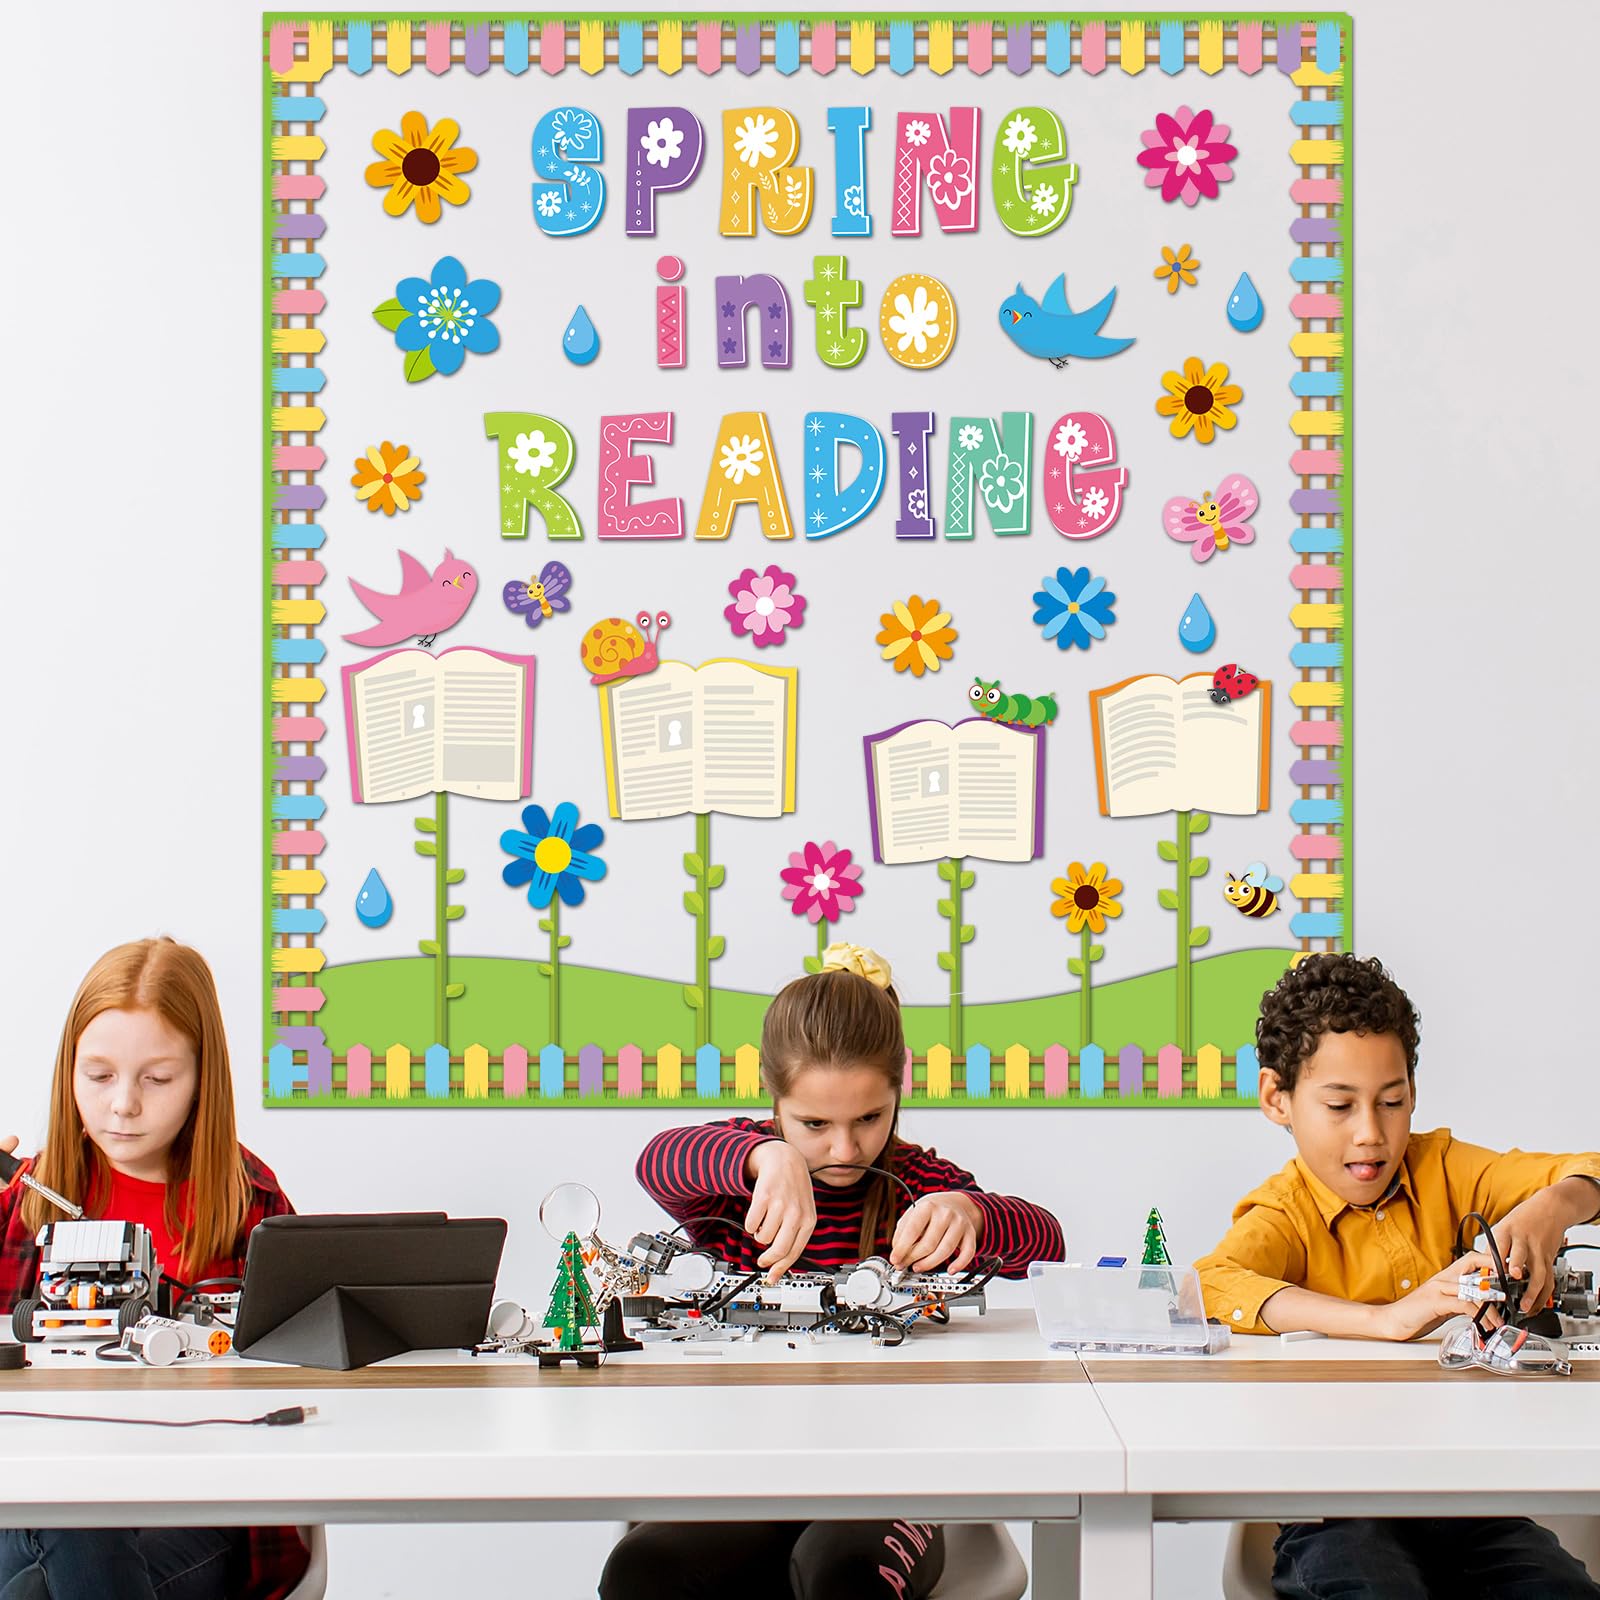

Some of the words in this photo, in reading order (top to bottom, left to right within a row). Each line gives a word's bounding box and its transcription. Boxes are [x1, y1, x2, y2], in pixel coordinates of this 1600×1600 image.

[532, 106, 1079, 237] SPRING
[656, 255, 958, 369] into
[484, 411, 1128, 540] READING
[879, 1517, 938, 1600] ARM
